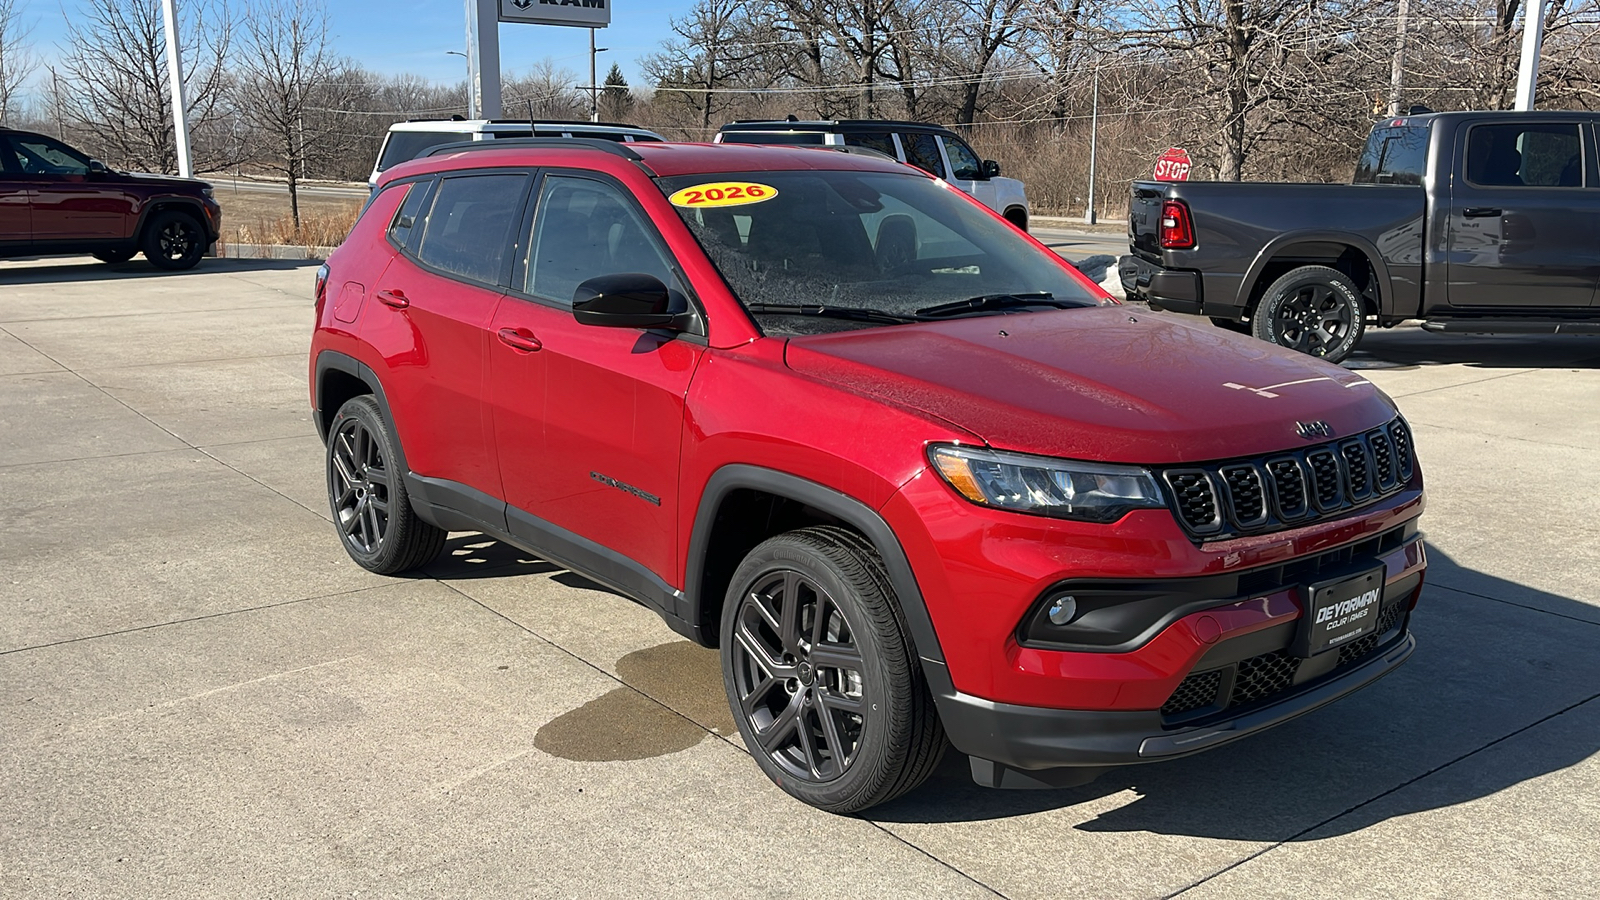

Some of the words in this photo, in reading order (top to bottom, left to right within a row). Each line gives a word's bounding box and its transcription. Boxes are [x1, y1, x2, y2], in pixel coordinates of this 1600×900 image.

[1157, 160, 1189, 179] STOP
[684, 186, 765, 204] 2026
[1295, 420, 1329, 437] Jeep
[1316, 588, 1379, 624] DEYARMAN
[1349, 608, 1368, 623] AMES
